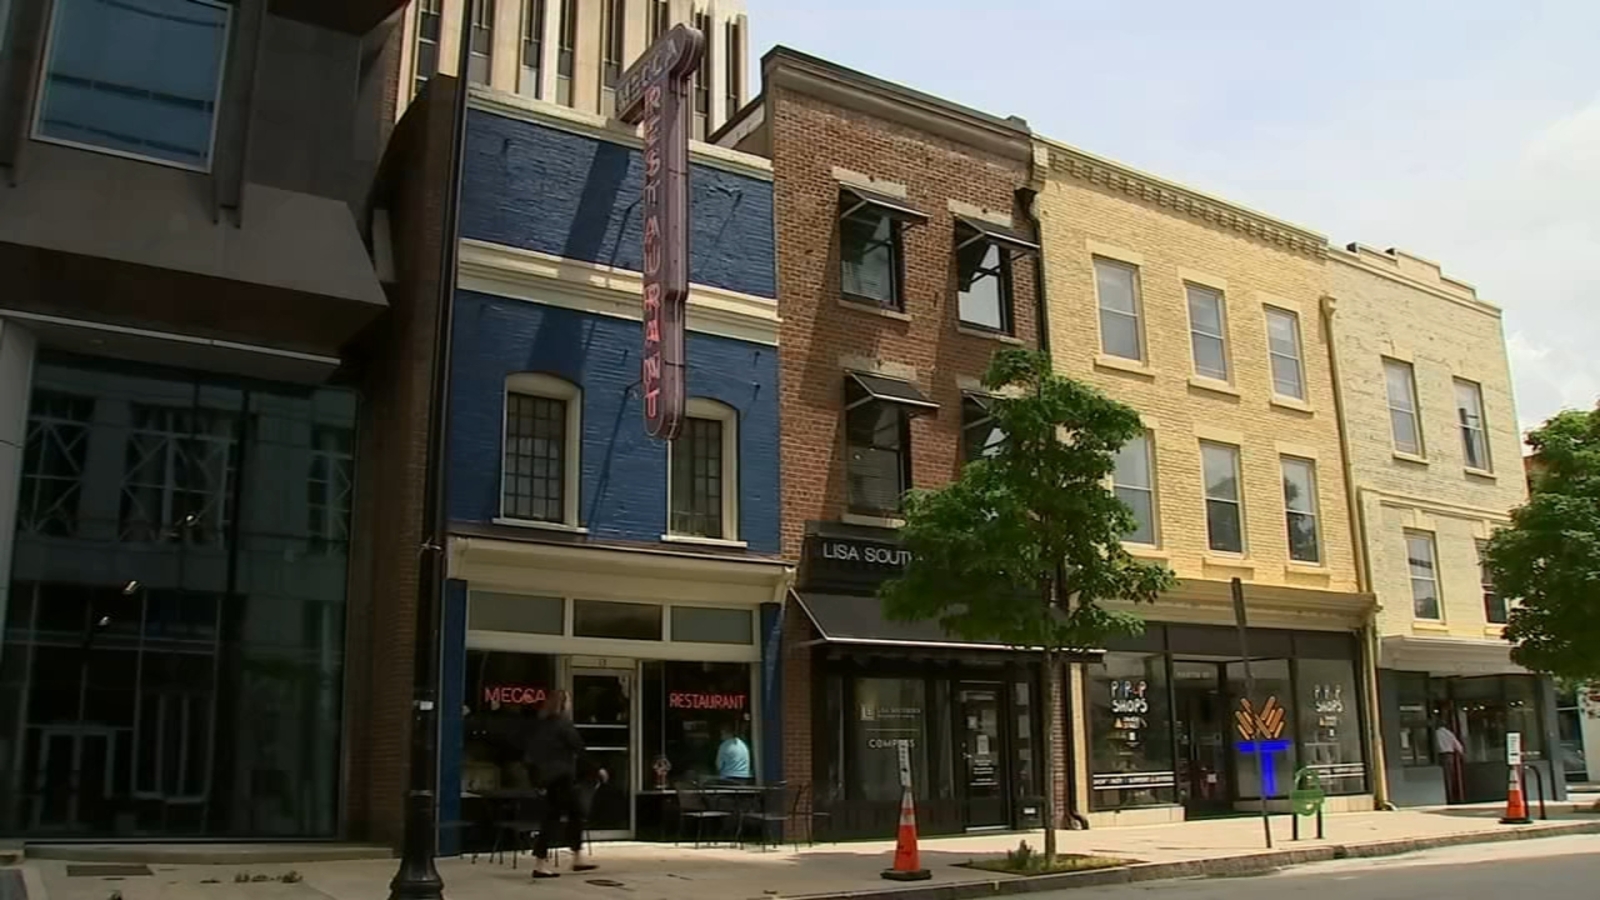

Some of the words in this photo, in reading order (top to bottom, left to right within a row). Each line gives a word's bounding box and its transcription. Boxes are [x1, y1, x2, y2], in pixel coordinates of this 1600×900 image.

[616, 37, 679, 114] MECCA
[644, 85, 661, 419] RESTAURANT
[822, 542, 860, 561] LISA
[485, 687, 547, 705] MECCA
[669, 692, 747, 710] RESTAURANT
[1112, 698, 1149, 713] SHOPS
[868, 738, 916, 749] COMPS
